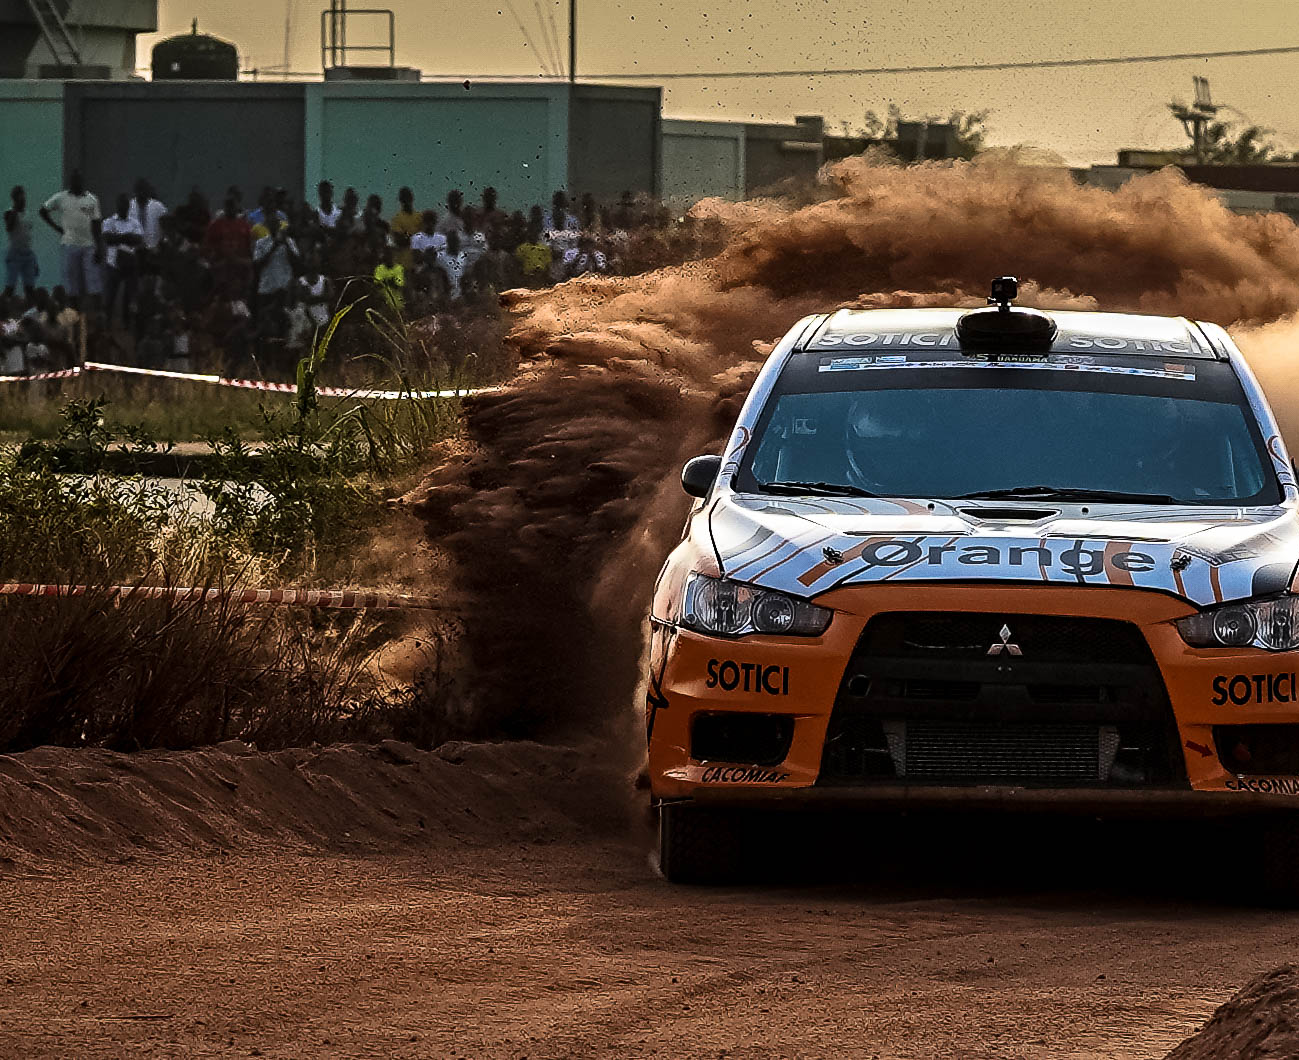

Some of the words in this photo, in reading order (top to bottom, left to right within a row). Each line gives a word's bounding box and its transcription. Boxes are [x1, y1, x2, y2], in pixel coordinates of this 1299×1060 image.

[818, 333, 956, 346] SOTICI
[1069, 335, 1202, 354] SOTICI
[706, 658, 790, 695] SOTICI
[1211, 672, 1297, 706] SOTICI
